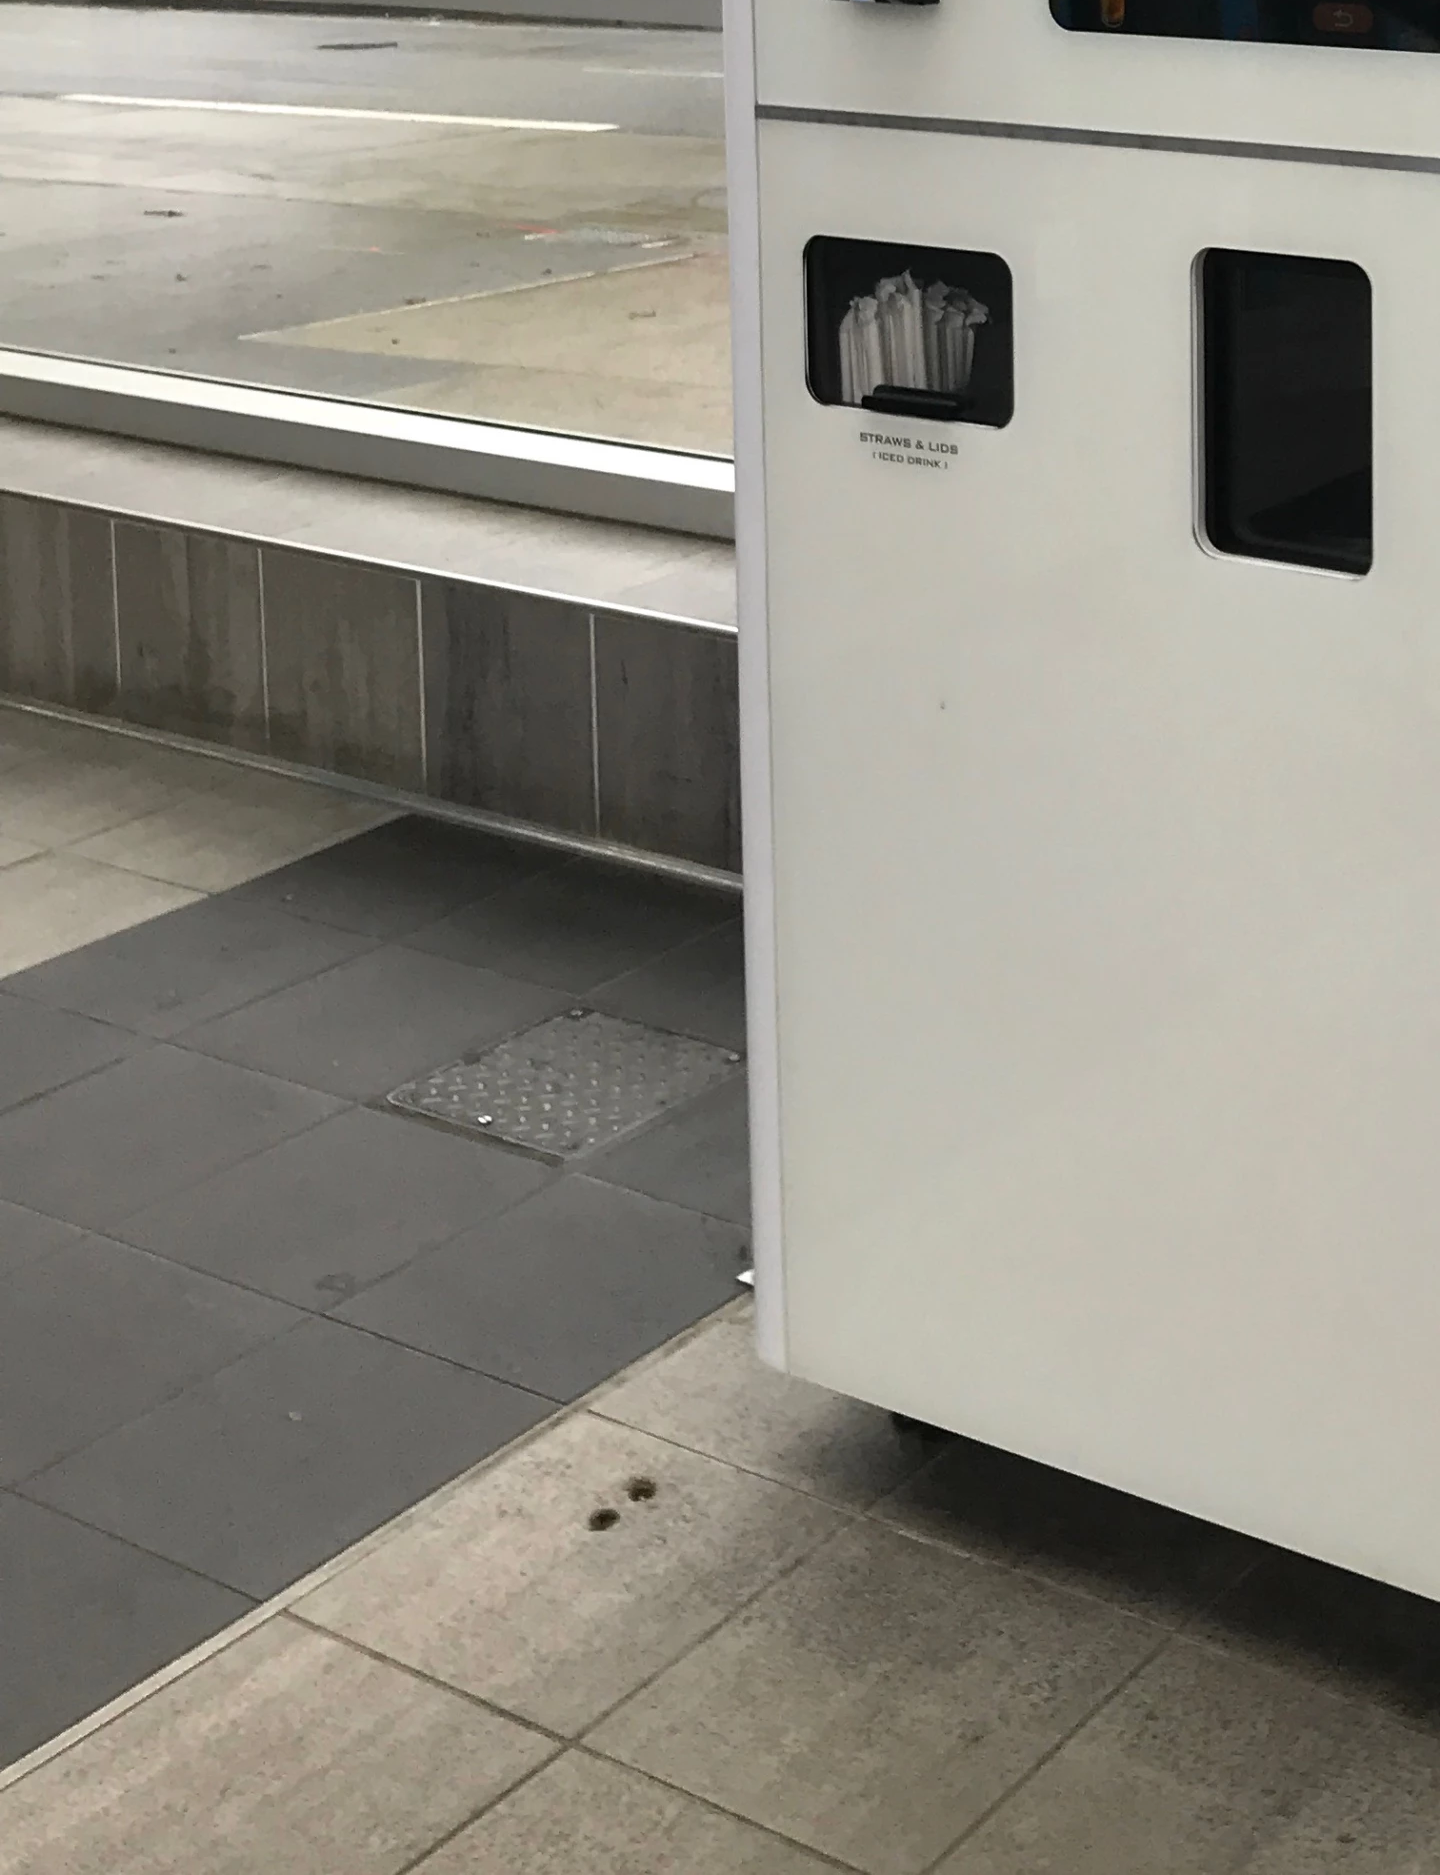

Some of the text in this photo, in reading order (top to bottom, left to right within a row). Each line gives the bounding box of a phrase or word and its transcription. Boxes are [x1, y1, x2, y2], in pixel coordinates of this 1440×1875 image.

[859, 431, 958, 455] STRAWS & LIDS
[879, 451, 904, 463] ICED
[907, 456, 942, 469] DRINK
